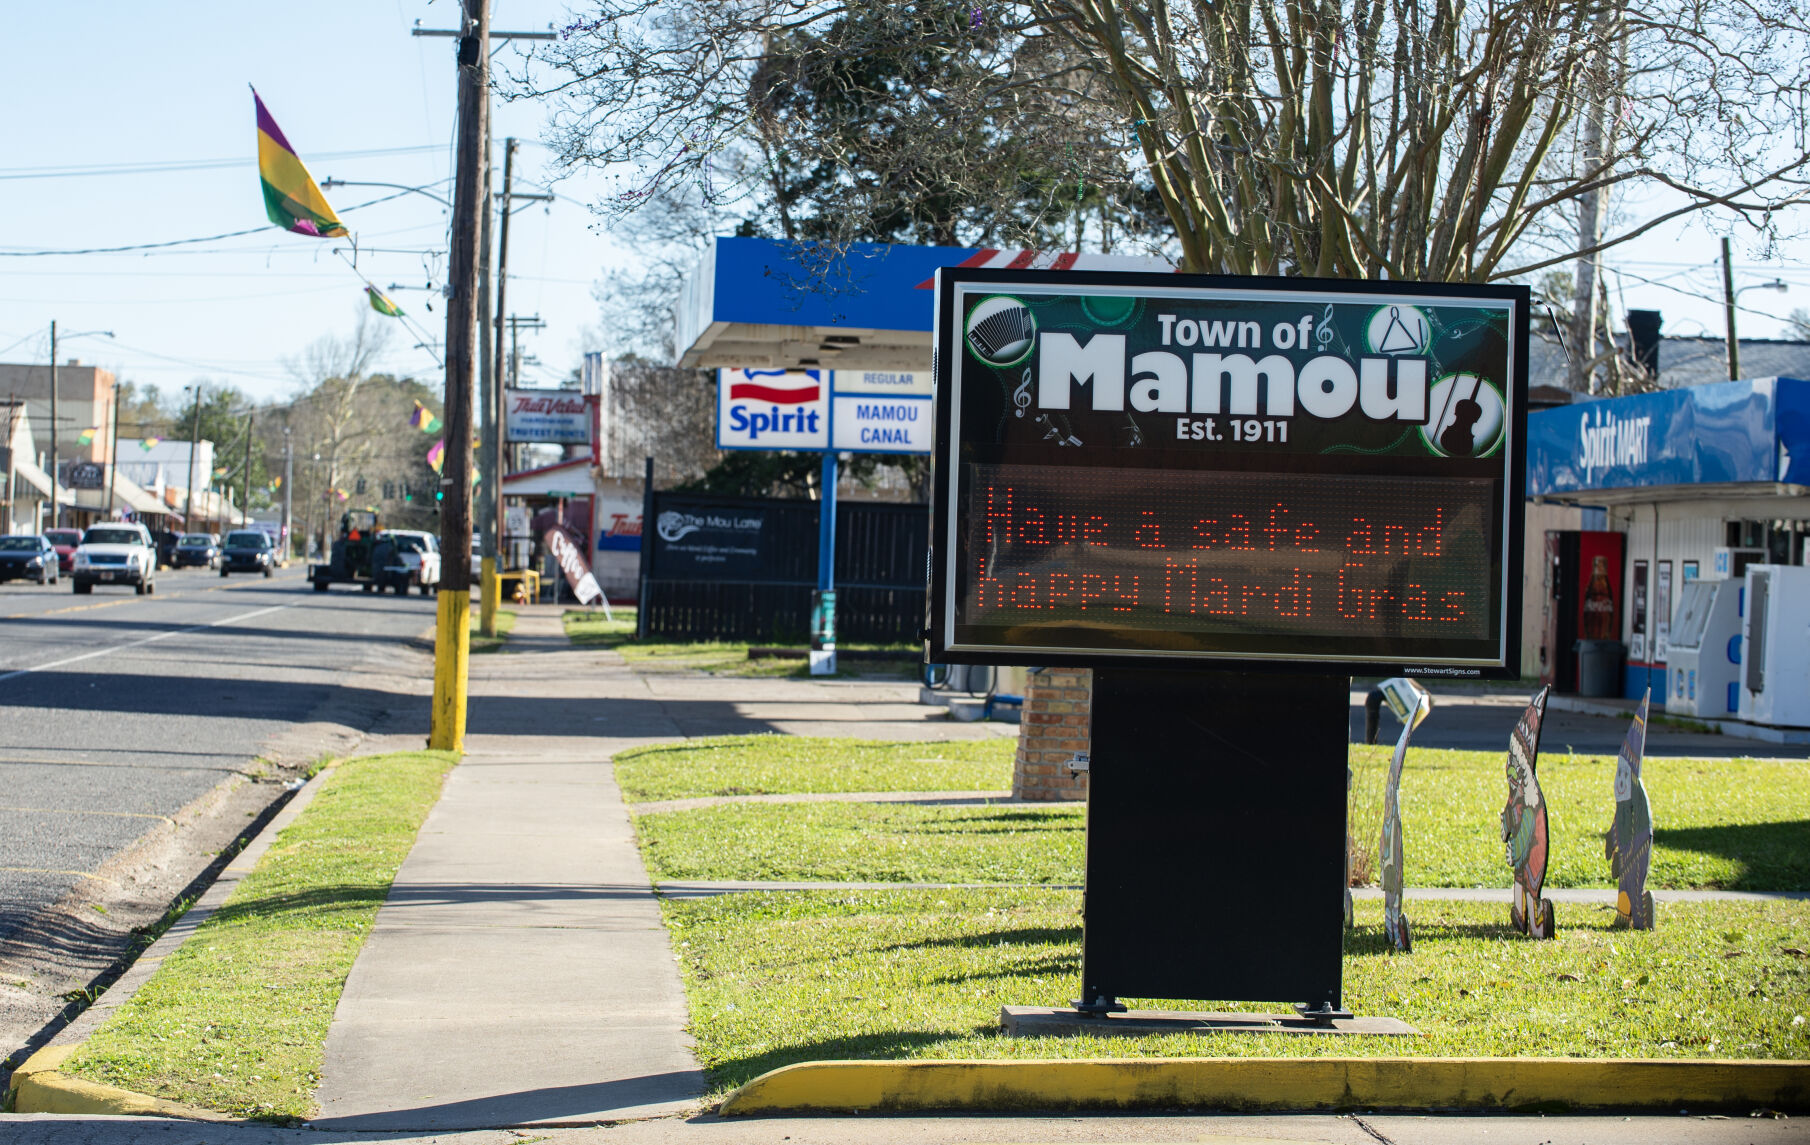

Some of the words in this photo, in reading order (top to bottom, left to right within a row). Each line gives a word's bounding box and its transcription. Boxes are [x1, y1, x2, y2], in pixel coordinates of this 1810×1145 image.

[1157, 314, 1261, 348] Town
[1271, 314, 1313, 350] of
[863, 372, 914, 385] REGULAR
[1038, 331, 1427, 421] Mamou
[730, 404, 820, 440] Spirit
[856, 404, 918, 422] MAMOU
[860, 427, 912, 445] CANAL
[1176, 417, 1223, 442] Est.
[1229, 418, 1288, 443] 1911
[1580, 406, 1616, 485] Spirit
[1617, 416, 1650, 467] MART
[683, 514, 705, 528] The
[986, 486, 1109, 547] Have
[1135, 511, 1166, 548] a
[1191, 502, 1321, 553] safe
[1346, 507, 1443, 557] and
[978, 558, 1140, 612] happy
[1165, 557, 1313, 617] Mardi
[1338, 563, 1466, 622] Gras
[1403, 667, 1481, 676] www.StewartSigns.com
[1668, 668, 1696, 700] ICE
